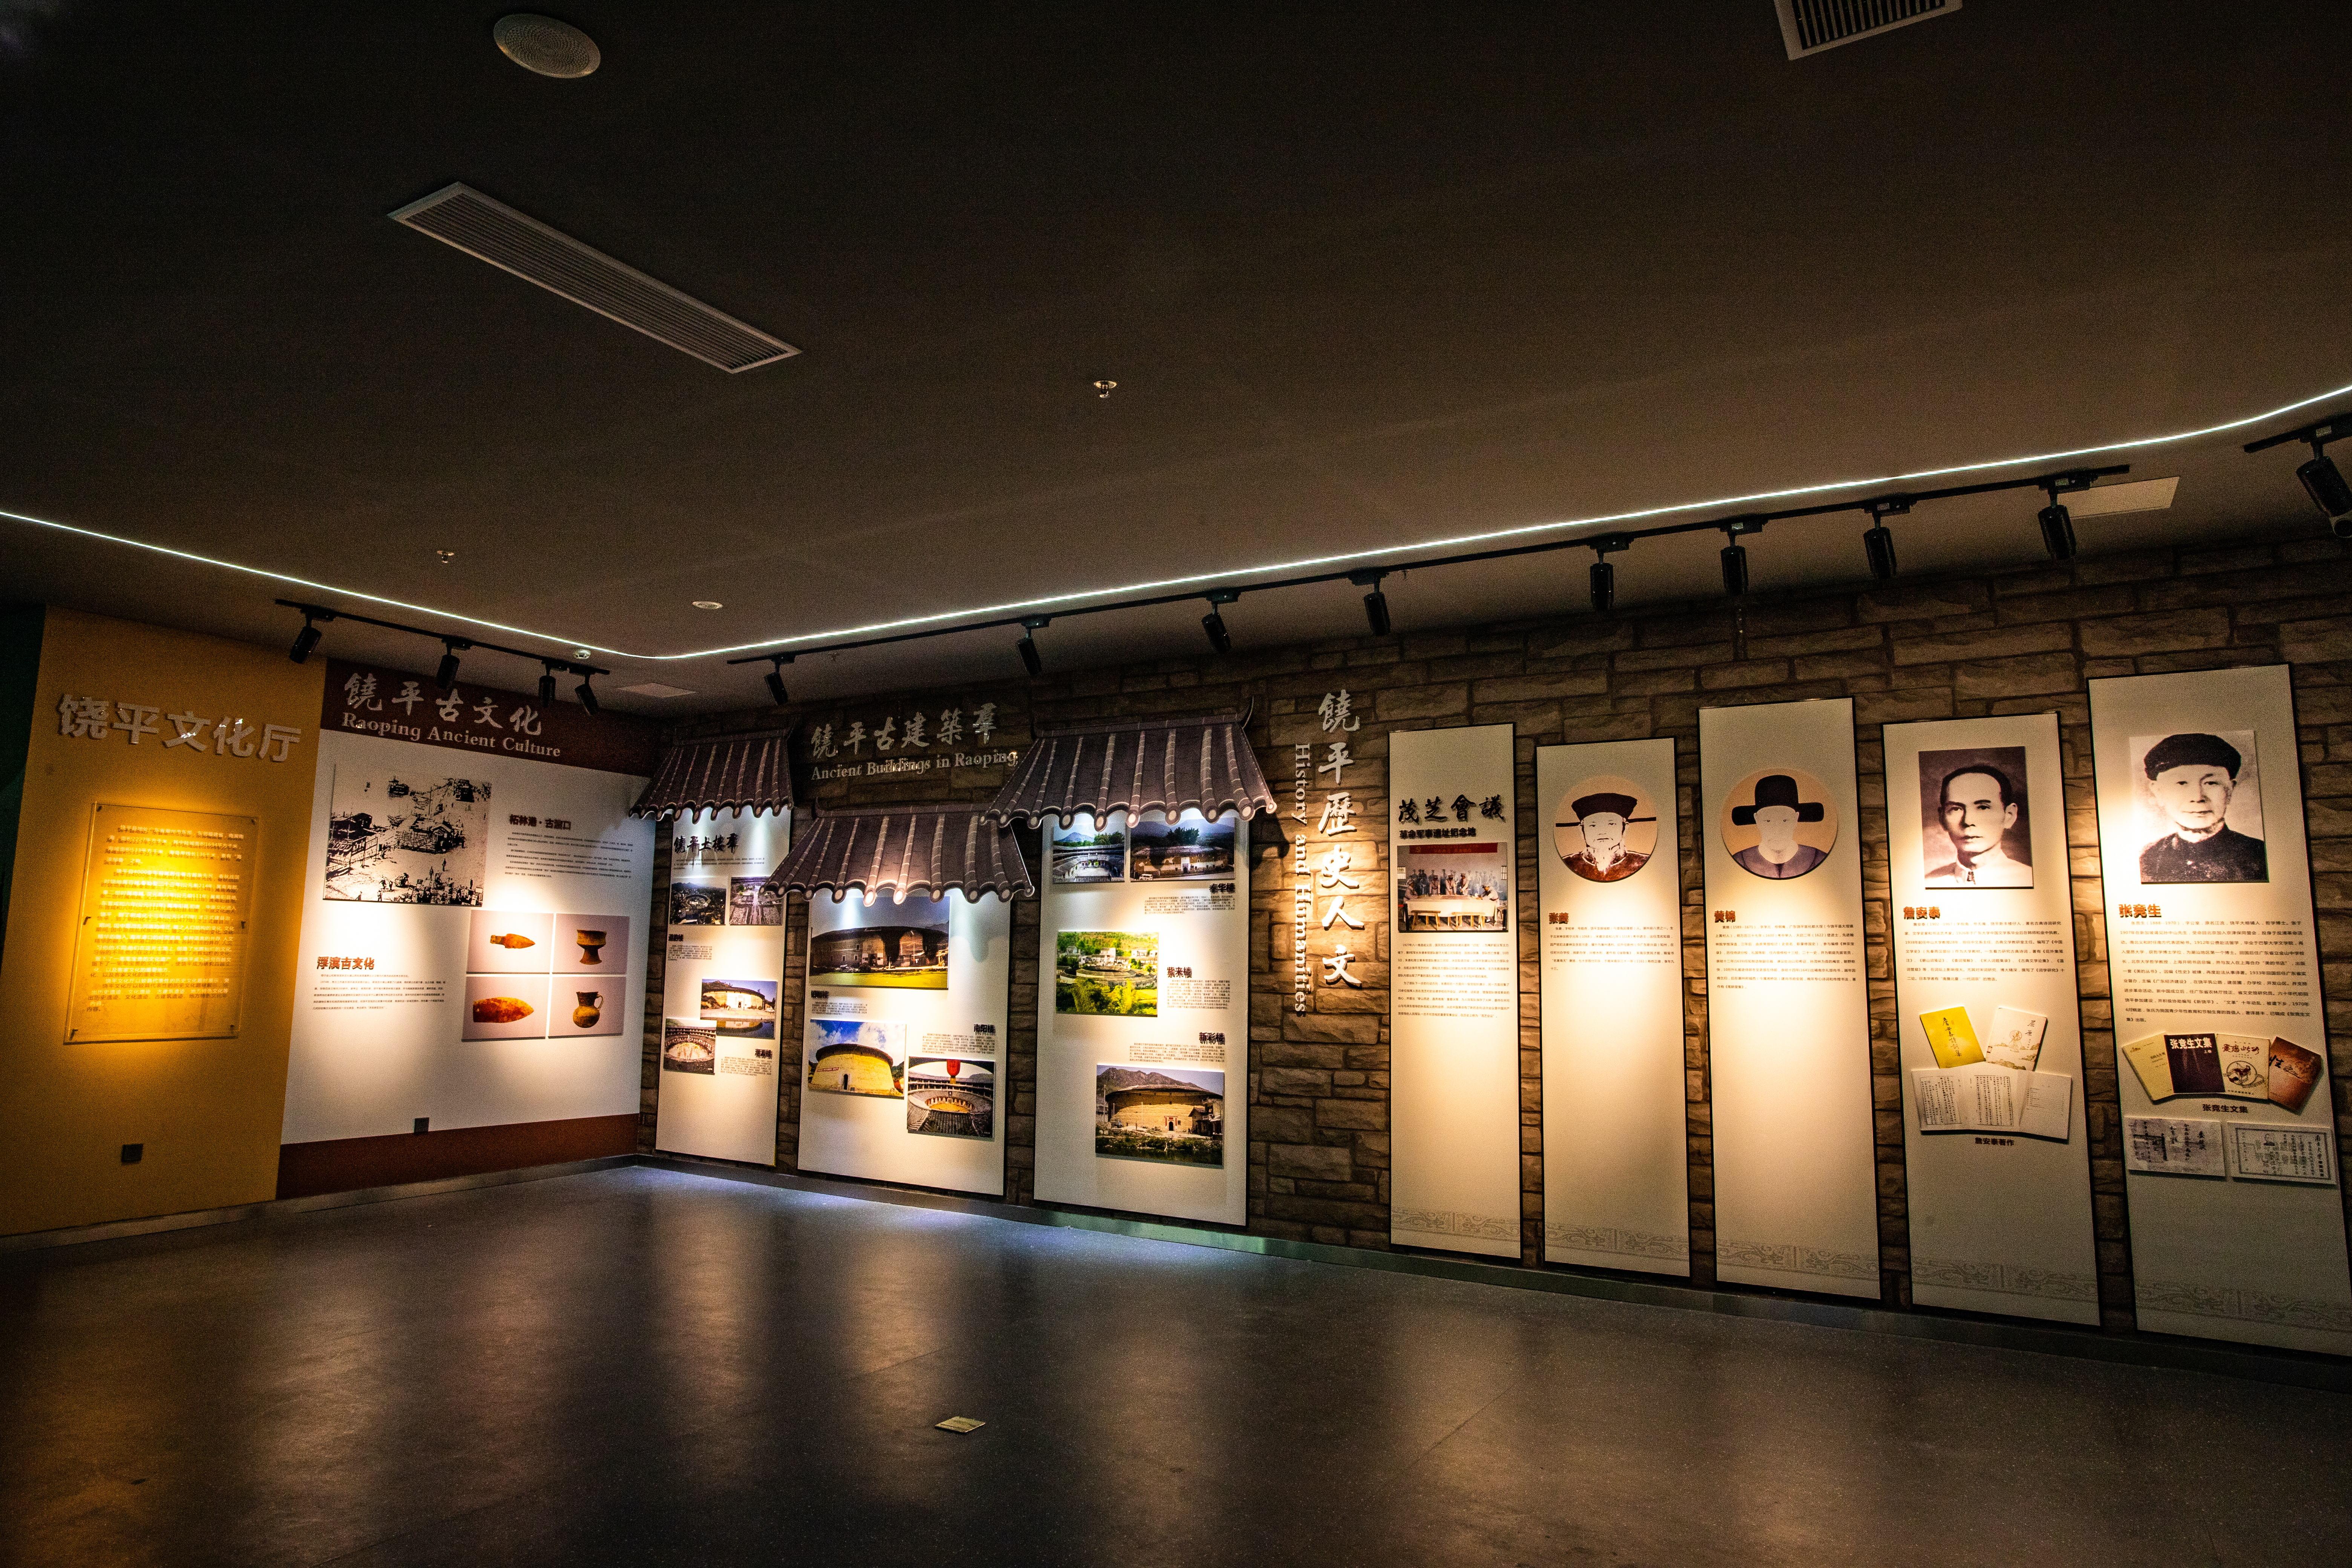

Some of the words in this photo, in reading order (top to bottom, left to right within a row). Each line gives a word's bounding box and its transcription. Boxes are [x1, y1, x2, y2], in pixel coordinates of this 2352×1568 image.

[58, 694, 301, 762] 饶平文化厅
[342, 712, 421, 741] Raoping
[427, 726, 497, 748] Ancient
[503, 737, 561, 757] Culture
[812, 764, 863, 781] Ancient
[867, 757, 931, 776] Buildings
[936, 755, 950, 768] in
[955, 750, 1018, 769] Raoping
[1291, 743, 1311, 826] History
[1399, 827, 1476, 839] 革命军事遗址纪念地
[1295, 834, 1311, 877] and
[1714, 910, 1736, 923] 黄锦
[1903, 906, 1940, 920] 詹安泰
[2119, 903, 2162, 918] 张竞生
[1295, 883, 1311, 1014] Humanities
[317, 957, 375, 970] 浮滨古文化
[1167, 967, 1192, 978] 紫来楼
[974, 1024, 996, 1033] 南阳楼
[1199, 1032, 1225, 1043] 新彩楼
[2170, 1037, 2212, 1049] 张竞生文集
[2202, 1104, 2248, 1113] 张竞生文集
[1975, 1137, 2014, 1147] 詹安泰著作
